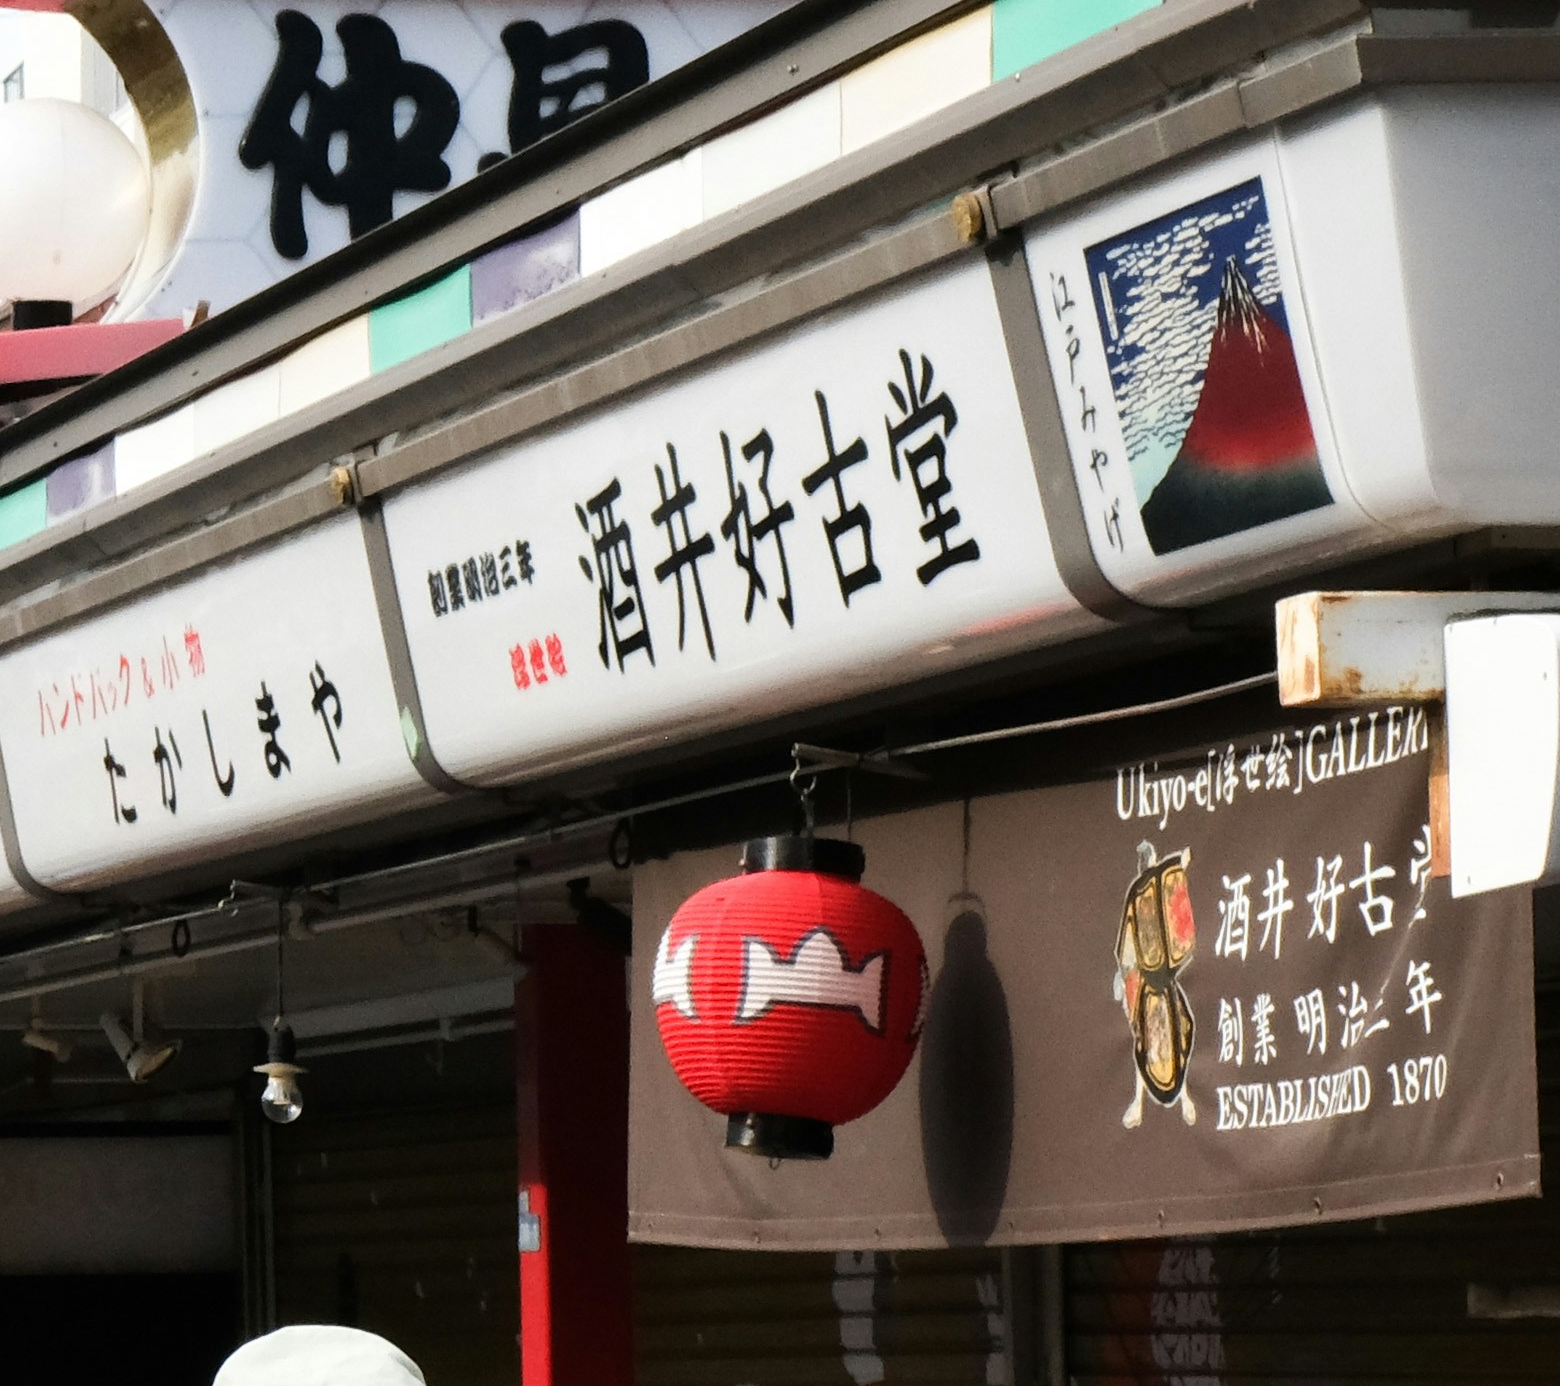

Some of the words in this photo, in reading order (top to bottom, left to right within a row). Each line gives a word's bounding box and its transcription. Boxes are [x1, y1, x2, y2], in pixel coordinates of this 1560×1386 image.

[574, 348, 982, 675] 酒井好古堂
[103, 659, 343, 825] たかしまや
[1386, 1054, 1448, 1106] 1870
